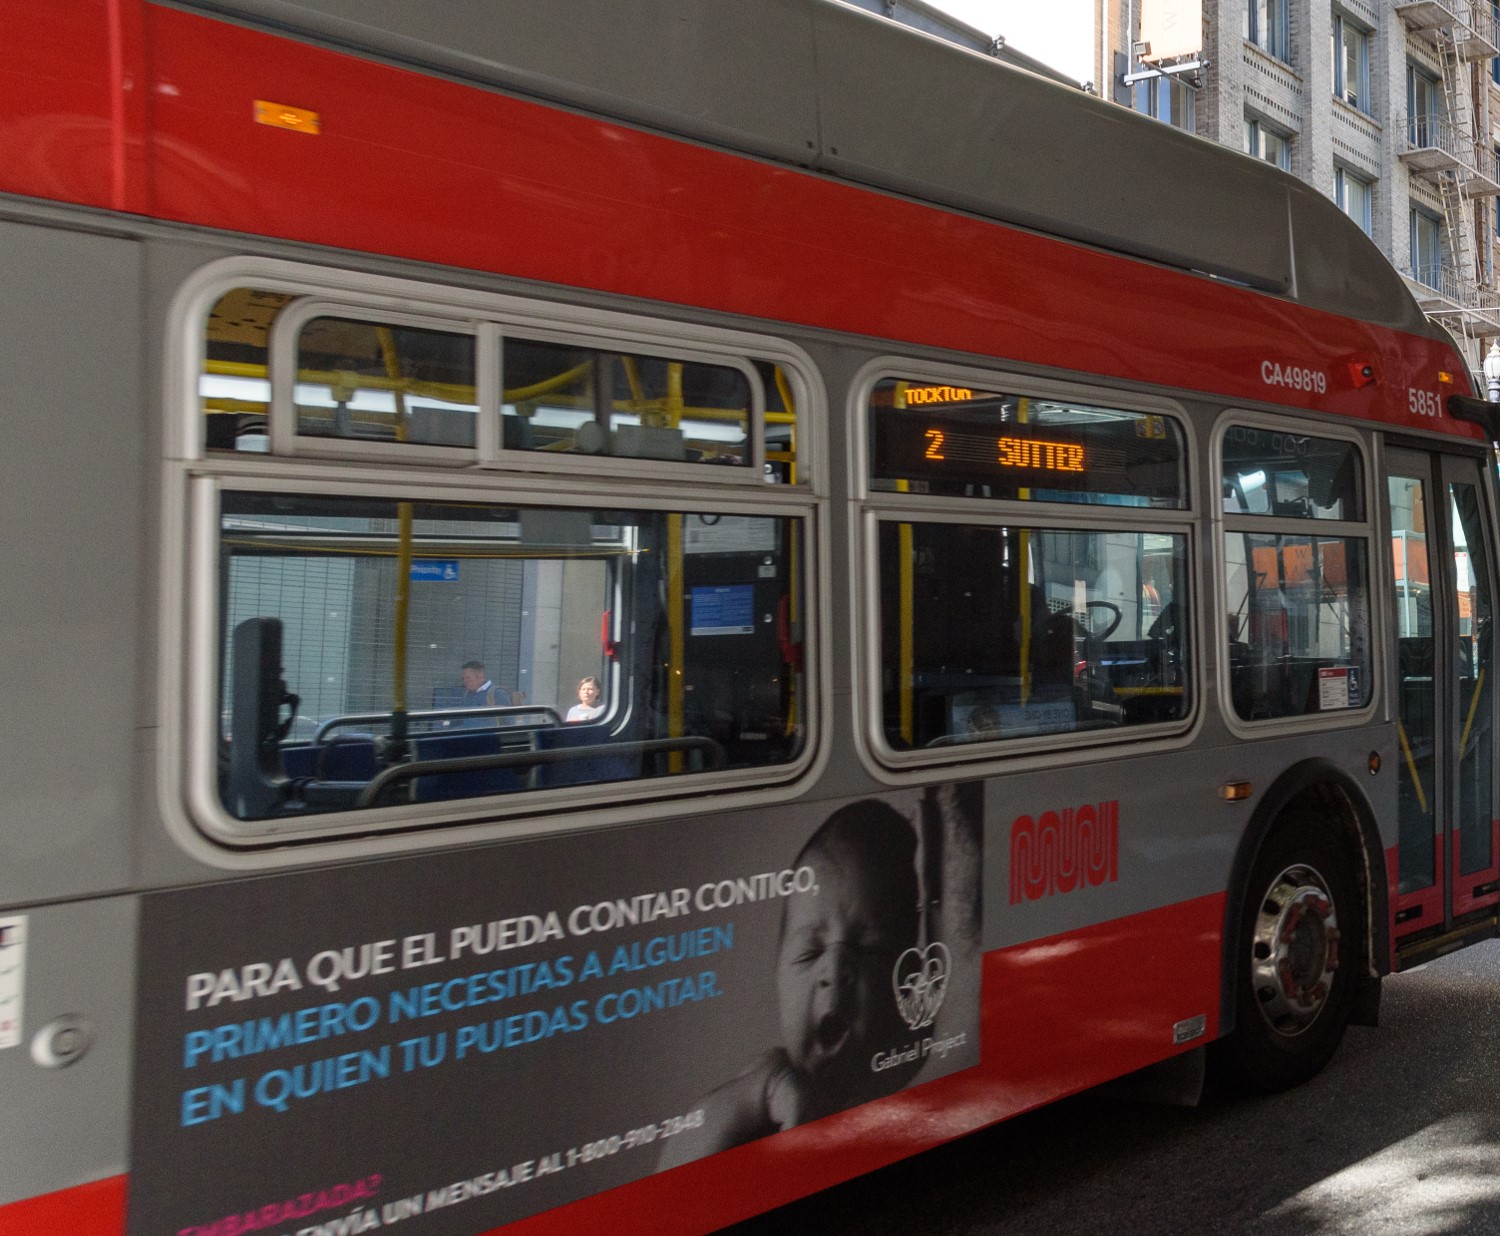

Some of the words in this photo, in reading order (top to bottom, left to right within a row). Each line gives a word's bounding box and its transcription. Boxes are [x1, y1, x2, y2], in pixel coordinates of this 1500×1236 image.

[1261, 360, 1326, 394] CA49819
[1408, 387, 1443, 418] 5851
[925, 430, 944, 459] 2
[998, 437, 1084, 472] SUTTER
[185, 957, 302, 1011] PARA
[306, 938, 396, 992] QUE
[402, 932, 446, 969] EL
[450, 911, 565, 960] PUEDA
[567, 887, 691, 936] CONTAR
[695, 866, 820, 911] CONTIGO,
[183, 996, 381, 1069] PRIMERO
[388, 956, 574, 1024] NECESITAS
[578, 951, 604, 982] A
[608, 922, 735, 976] ALGUIEN
[180, 1078, 245, 1127] EN
[254, 1045, 392, 1113] QUIEN
[397, 1032, 447, 1073] TU
[455, 1000, 589, 1060] PUEDAS
[595, 970, 724, 1024] CONTAR.
[870, 1041, 919, 1072] Gabriel
[921, 1032, 967, 1059] Project
[381, 1193, 424, 1225] UN
[424, 1160, 535, 1213] MENSAJE
[534, 1152, 566, 1178] AL
